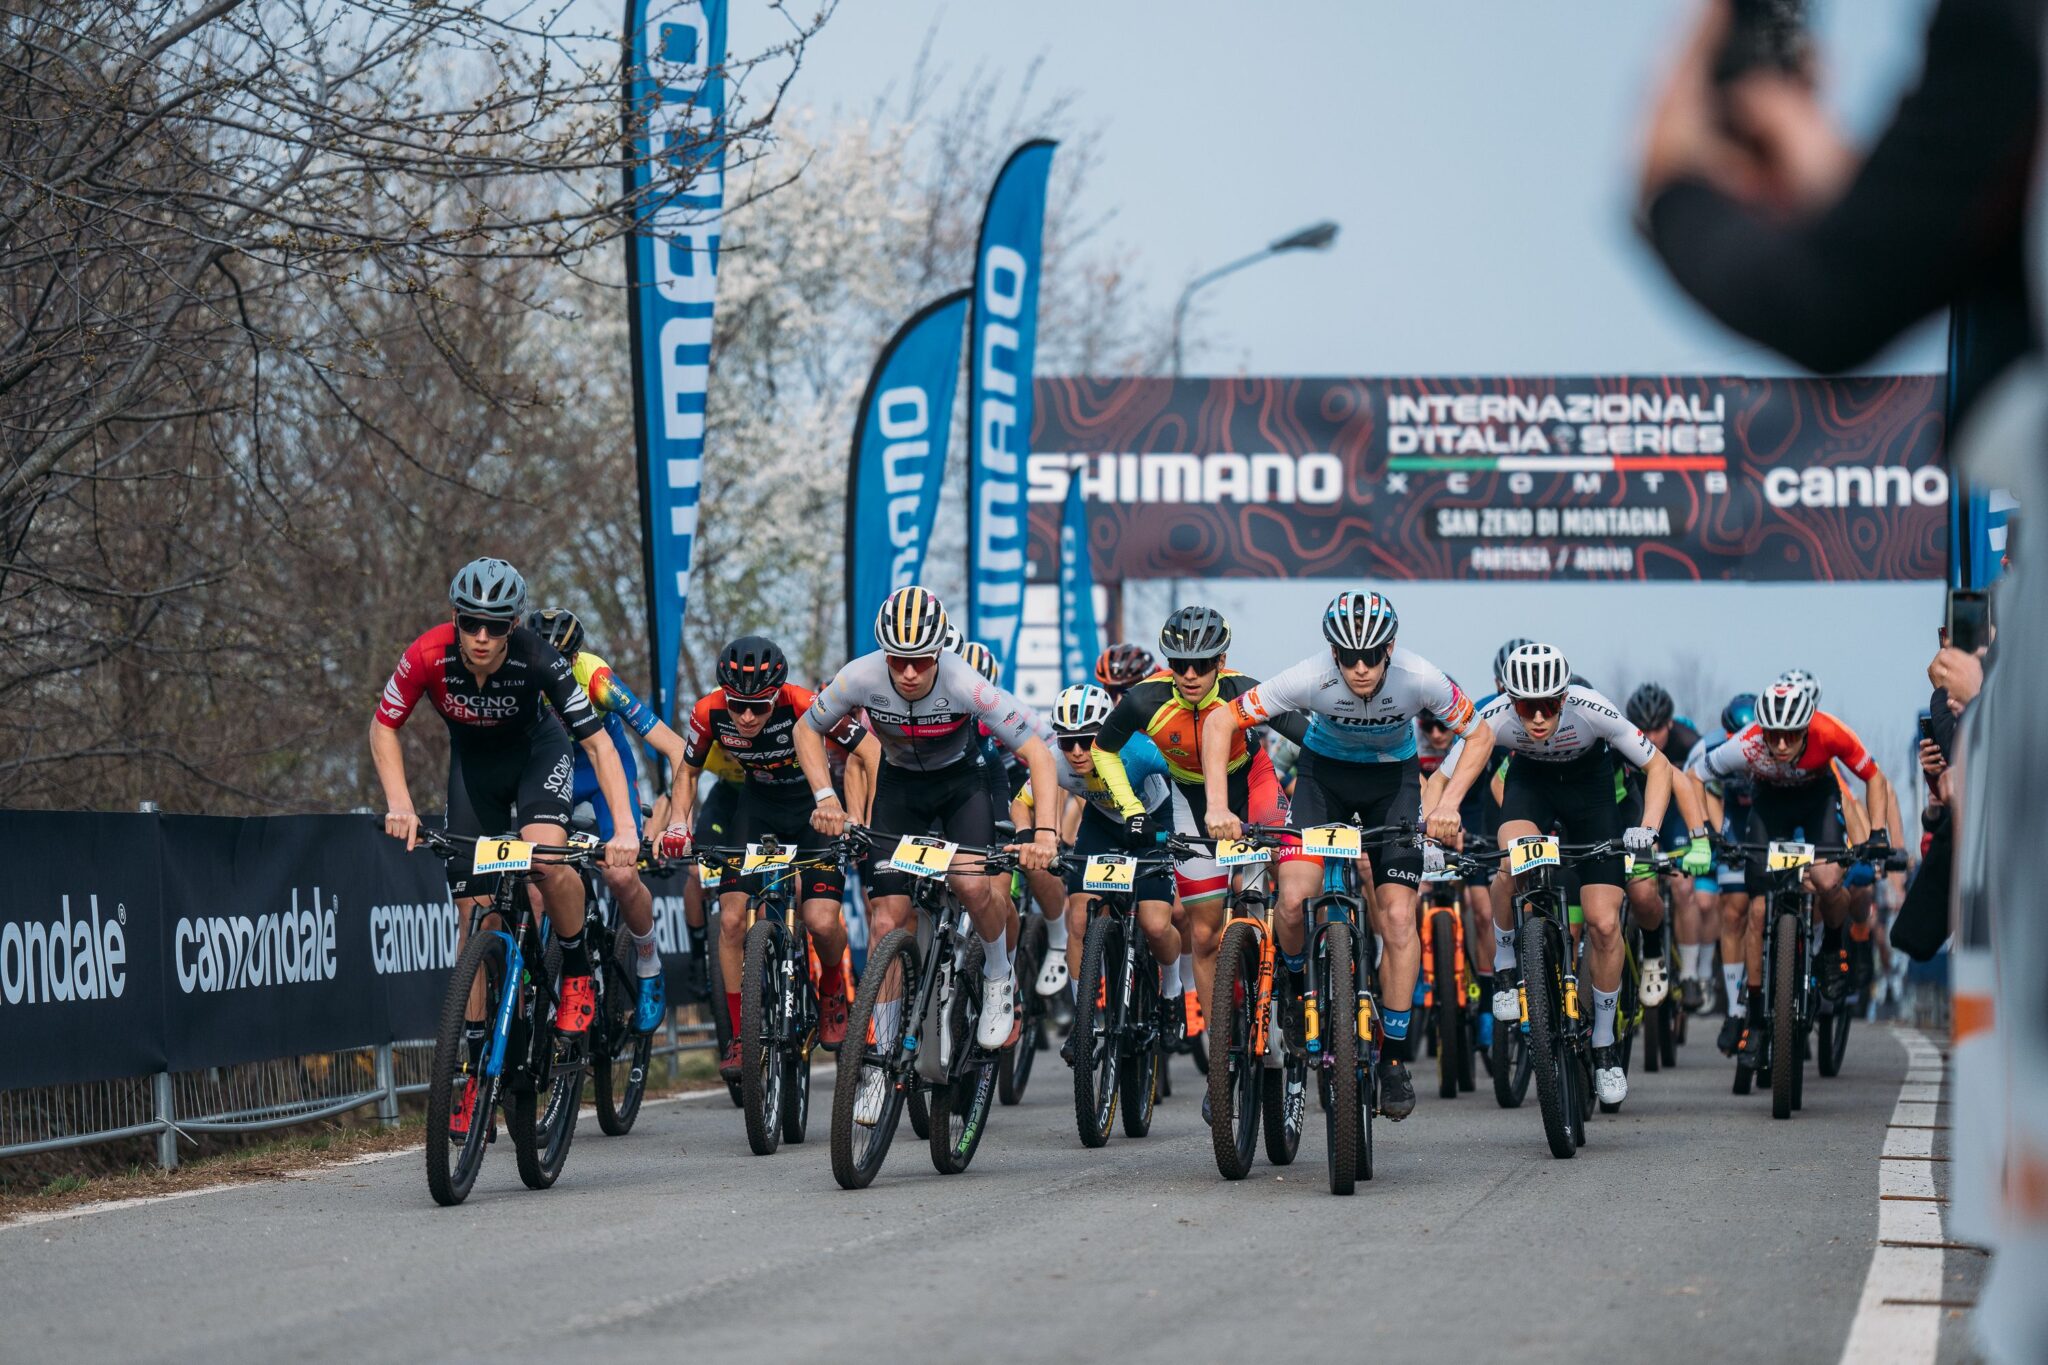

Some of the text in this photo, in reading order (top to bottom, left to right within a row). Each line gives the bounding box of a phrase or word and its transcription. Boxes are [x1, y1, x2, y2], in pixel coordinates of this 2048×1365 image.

[1387, 393, 1725, 423] INTERNAZIONALI
[1387, 425, 1725, 454] D'ITALIA SERIES
[1026, 453, 1343, 503] SHIMANO
[1437, 506, 1671, 537] SAN ZENO DI MONTAGNA
[1470, 547, 1551, 571] PARTENZA
[1573, 547, 1634, 571] ARRIVO
[444, 693, 517, 707] SOGNO
[441, 702, 520, 718] VENETO
[870, 709, 952, 725] ROCK BIKE
[1327, 713, 1406, 726] TRINX
[543, 754, 571, 793] SOGNO
[1131, 816, 1145, 834] FOX
[1325, 829, 1337, 846] 7
[497, 841, 511, 861] 6
[914, 846, 929, 865] 1
[1218, 853, 1268, 865] SHIMANO
[1305, 845, 1358, 856] SHIMANO
[1522, 843, 1544, 863] 10
[476, 860, 528, 872] SHIMANO
[893, 860, 945, 878] SHIMANO
[1514, 857, 1557, 873] SHIMANO
[1782, 855, 1800, 868] 17
[1102, 864, 1116, 882] 2
[1086, 881, 1130, 890] SHIMANO
[175, 886, 337, 994] cannondale
